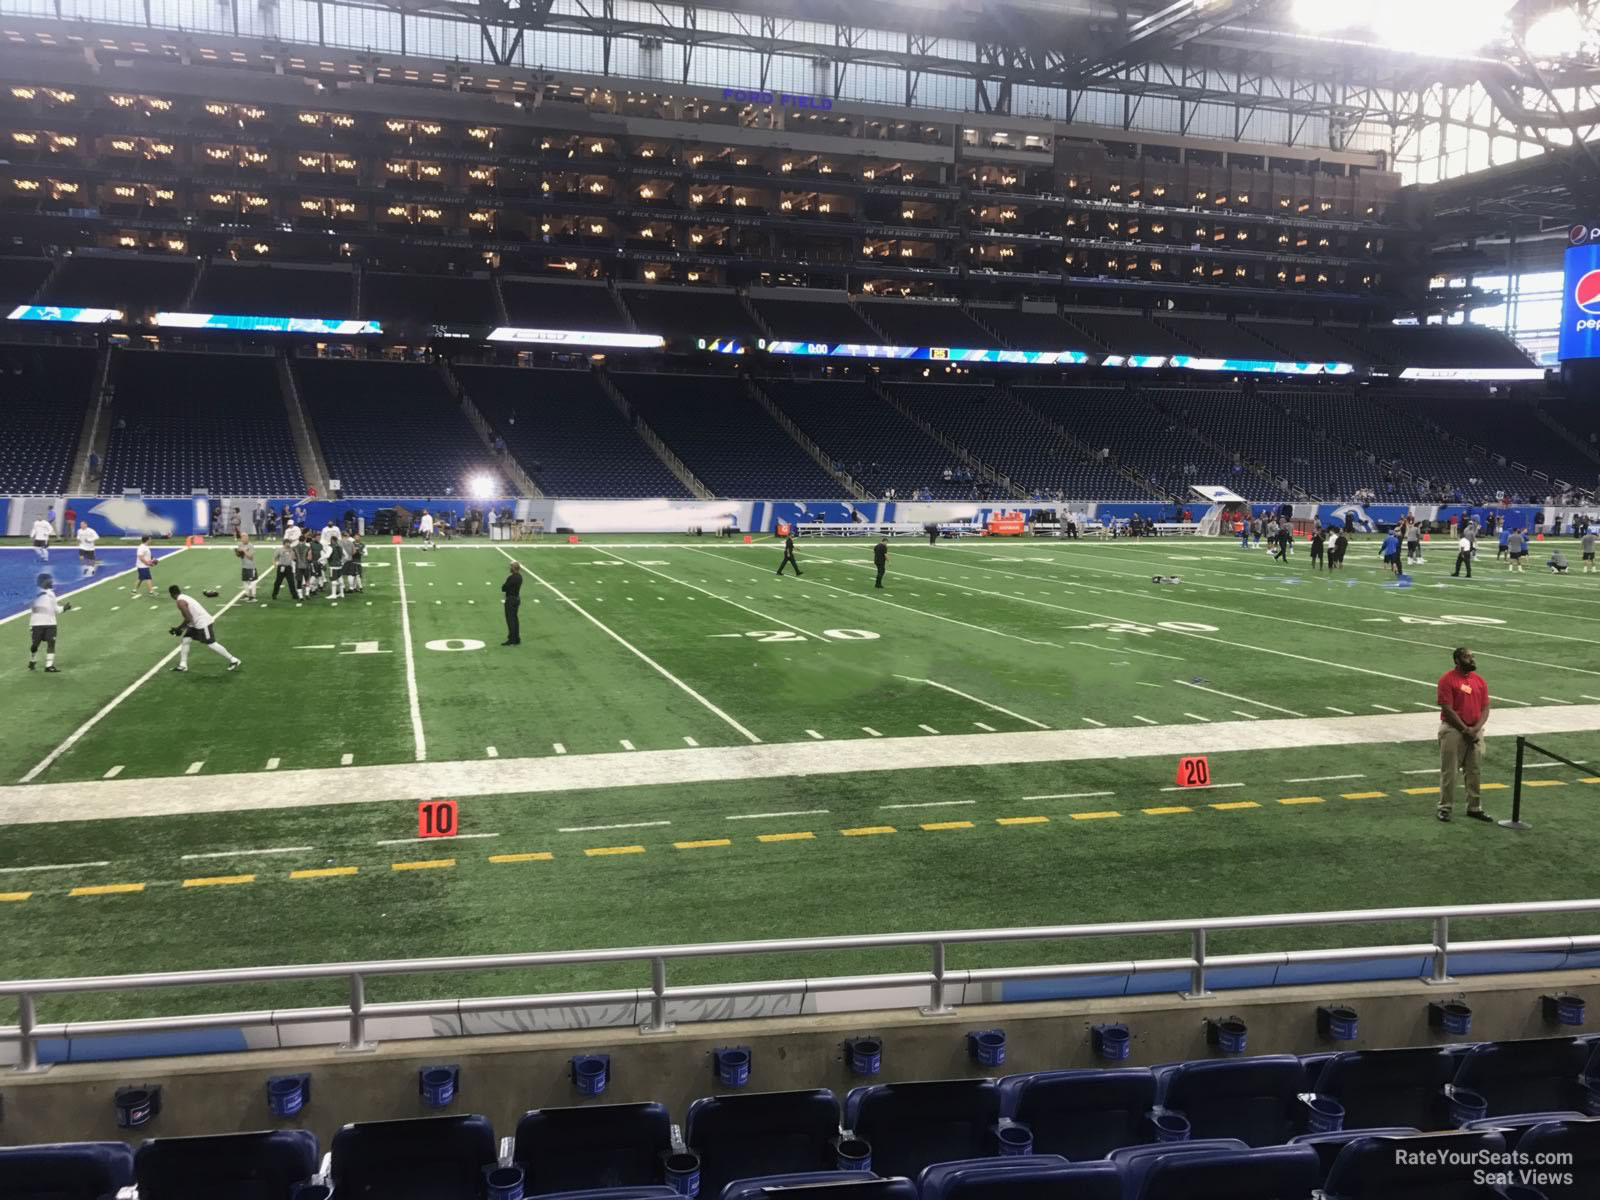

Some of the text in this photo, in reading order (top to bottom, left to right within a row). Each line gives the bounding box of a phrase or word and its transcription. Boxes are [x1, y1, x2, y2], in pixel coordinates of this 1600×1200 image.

[723, 88, 833, 111] FORD FIELD
[807, 343, 828, 355] 0:00
[745, 628, 881, 643] 20
[1088, 621, 1220, 637] 30
[339, 638, 486, 655] 10
[1184, 759, 1208, 785] 20
[422, 803, 453, 834] 10
